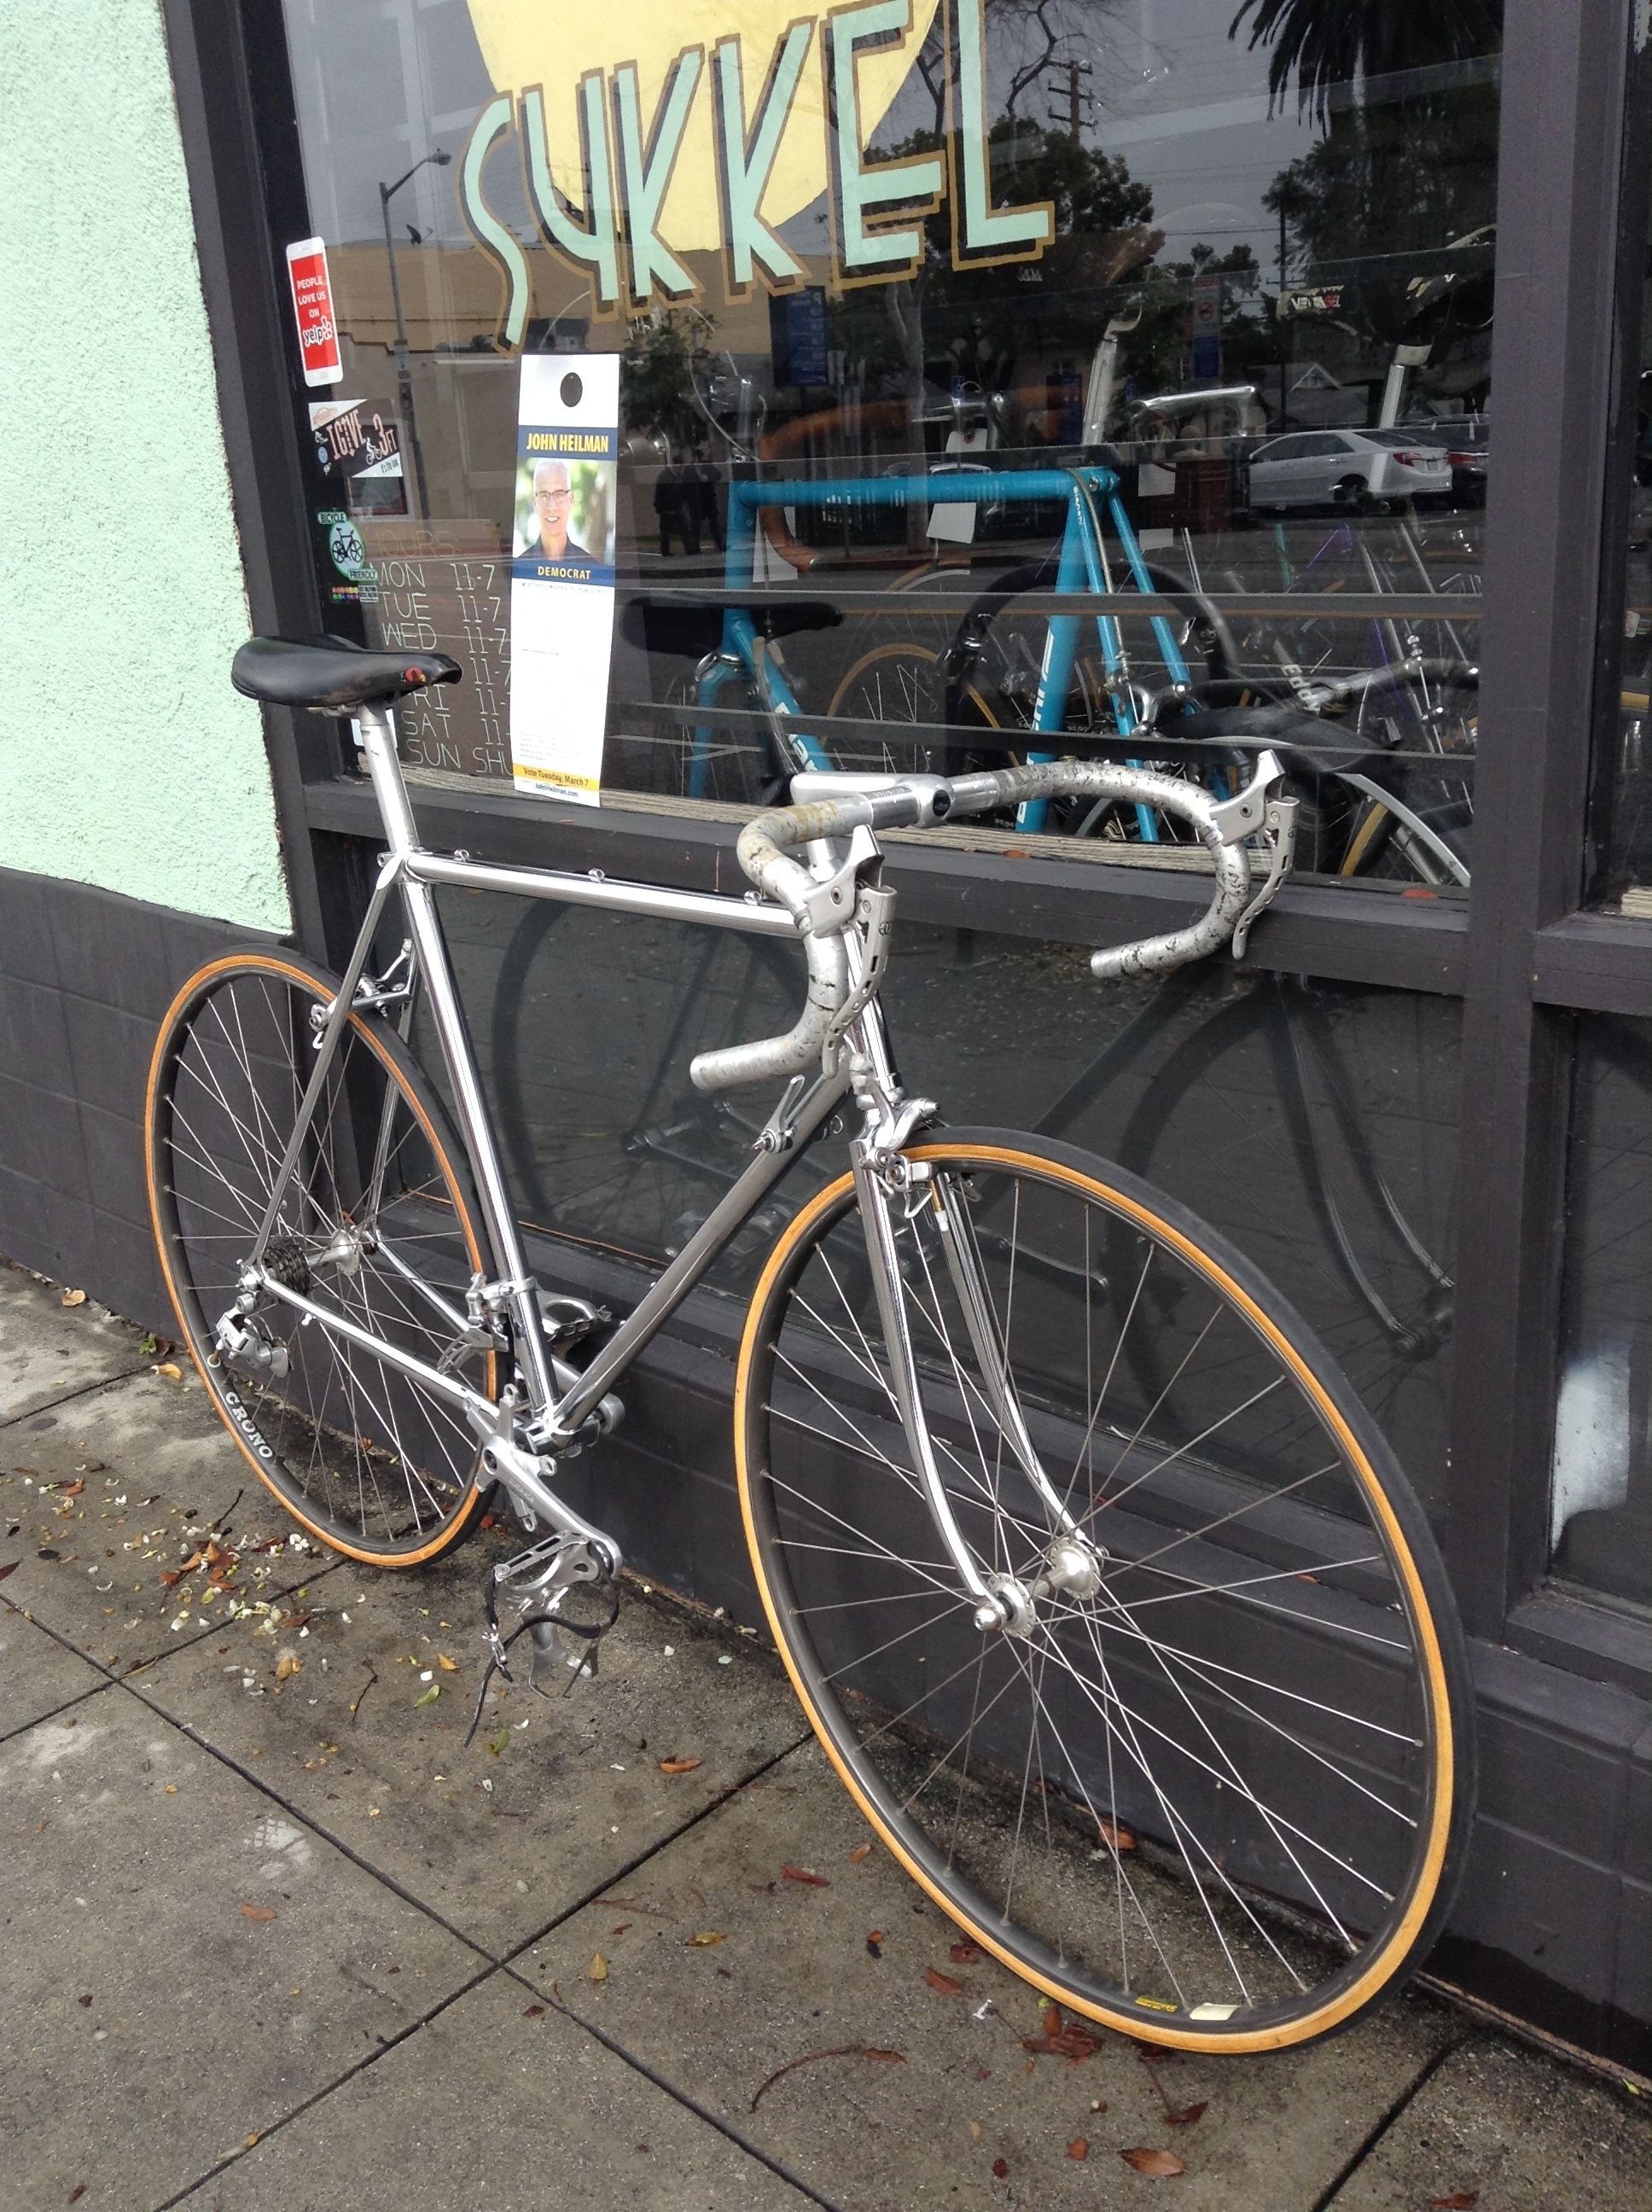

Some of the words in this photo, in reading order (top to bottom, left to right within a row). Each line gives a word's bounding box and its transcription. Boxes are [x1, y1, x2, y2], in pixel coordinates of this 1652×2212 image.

[455, 0, 1056, 358] SYKKEL
[296, 276, 323, 289] PEOPLE
[298, 293, 317, 306] LOVE
[316, 290, 327, 301] US
[309, 308, 321, 318] ON
[303, 326, 324, 346] yelp
[526, 433, 558, 451] JOHN
[559, 434, 608, 453] HEILMAN
[320, 513, 346, 523] BICYCLE
[349, 570, 376, 579] FRIENDLY
[369, 562, 426, 588] MON
[537, 566, 591, 580] DEMOCRAT
[377, 591, 432, 620] TUE
[458, 595, 501, 624] 11-7
[381, 622, 437, 649] WED
[463, 626, 507, 655] 11-7
[407, 684, 450, 711] RI
[475, 688, 511, 716] 11-
[401, 711, 451, 739] SAT
[405, 739, 462, 769] SUN
[523, 767, 538, 777] Vote
[538, 770, 565, 783] Tuesday,
[564, 775, 584, 786] March
[584, 778, 589, 787] 7
[225, 1391, 273, 1458] CRONO
